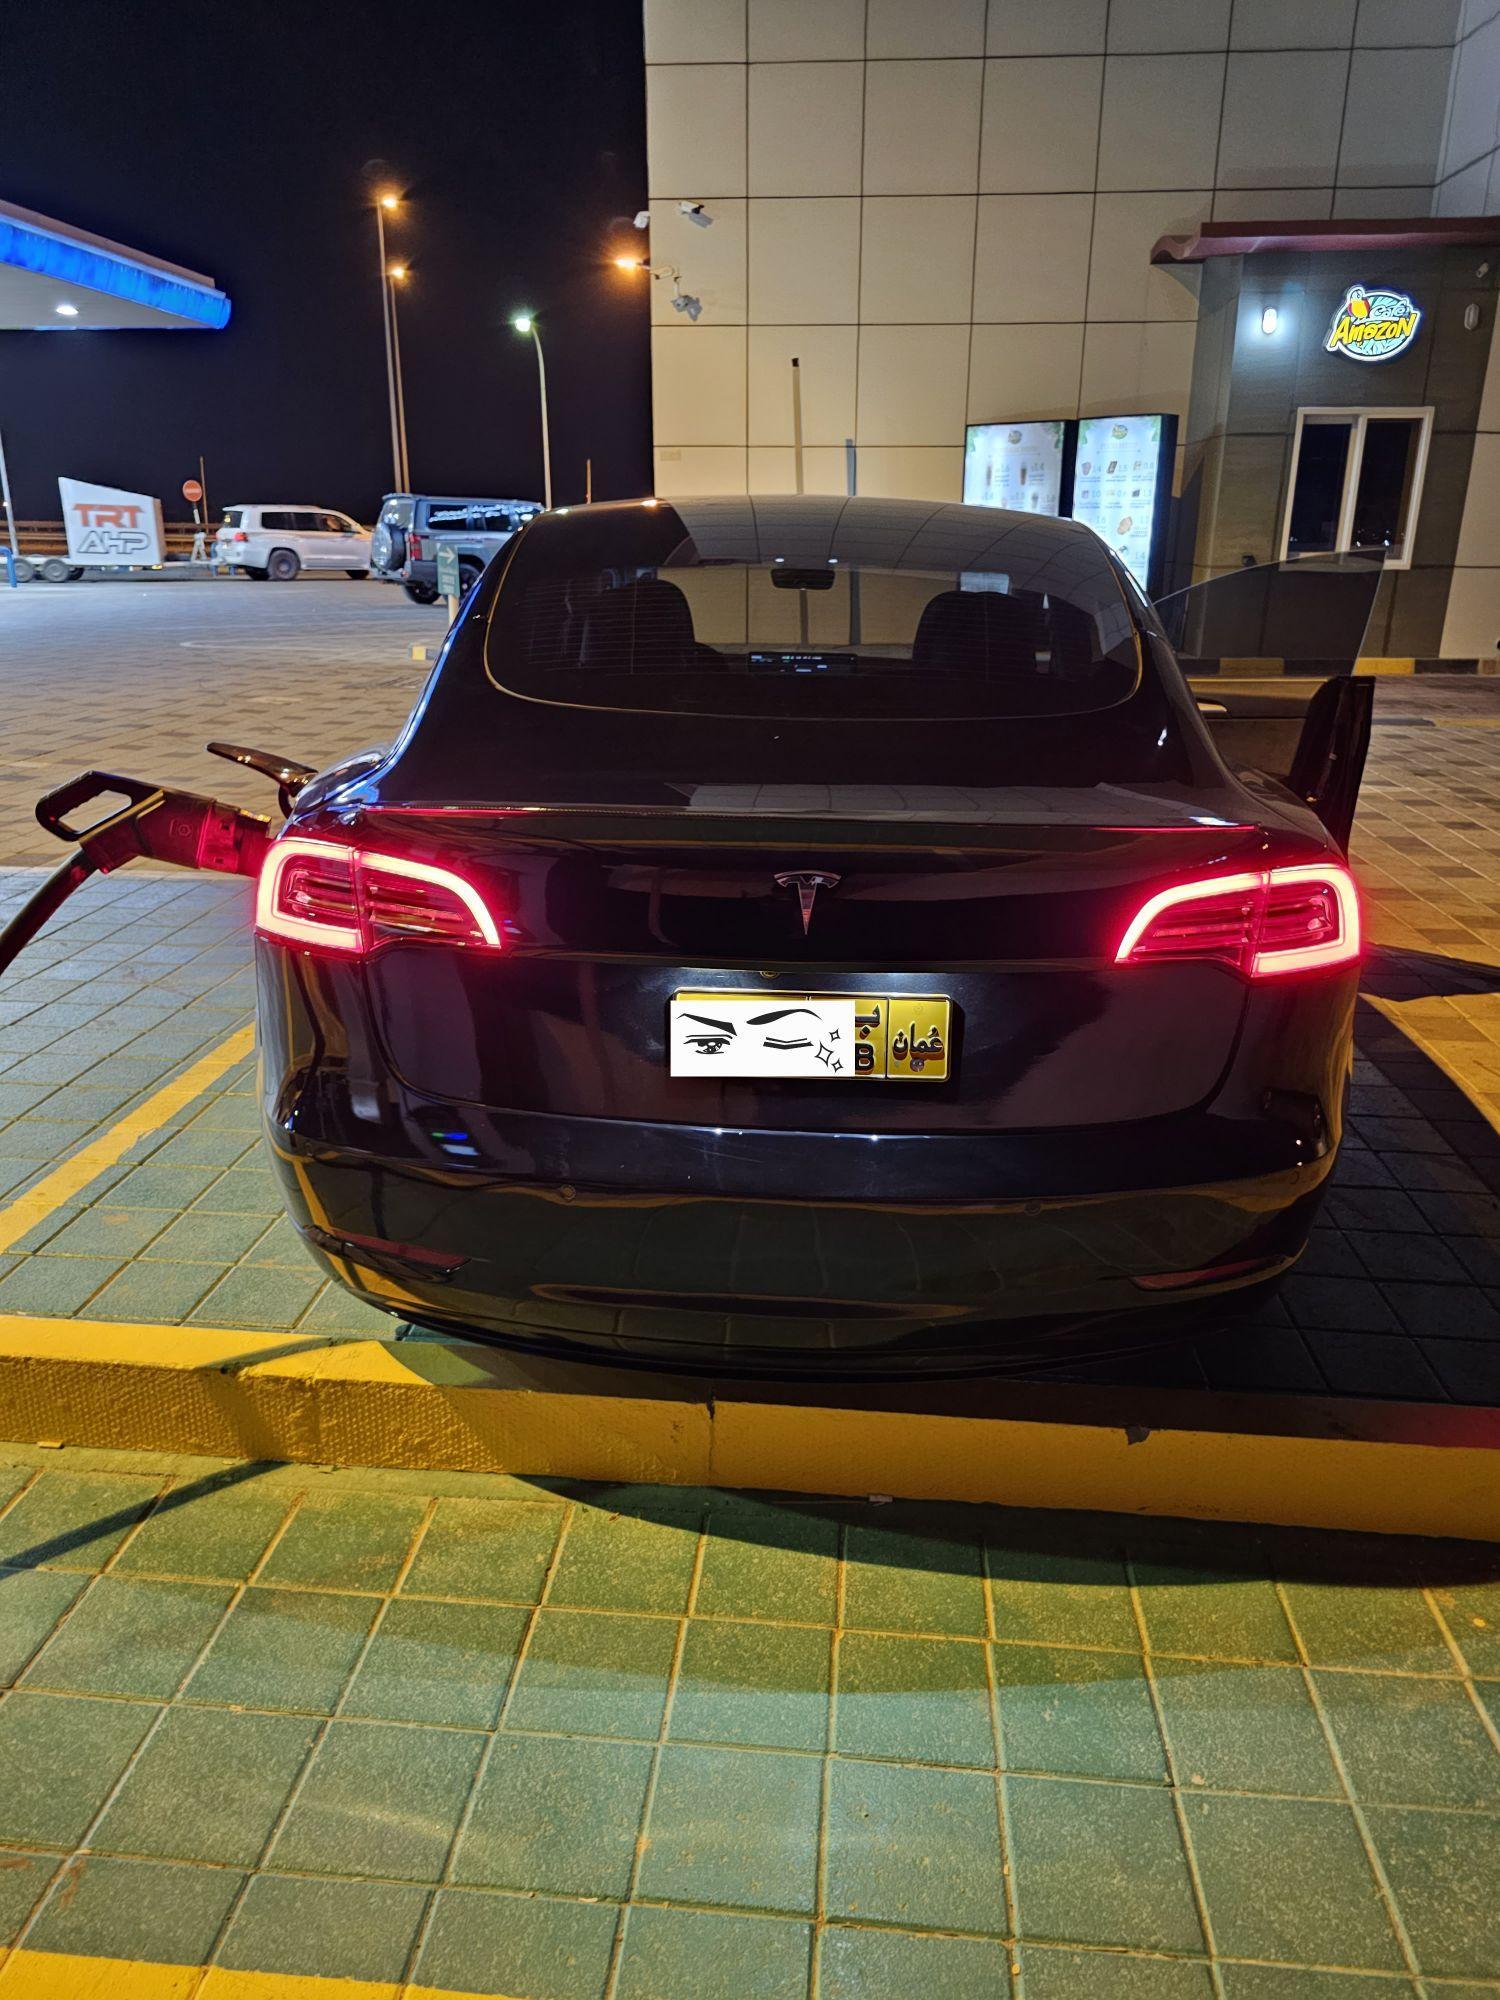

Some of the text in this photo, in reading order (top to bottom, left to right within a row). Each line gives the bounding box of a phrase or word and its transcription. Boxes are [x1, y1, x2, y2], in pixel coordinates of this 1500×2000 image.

[73, 504, 144, 528] TRT
[77, 530, 151, 555] AHP
[855, 1042, 875, 1075] B
